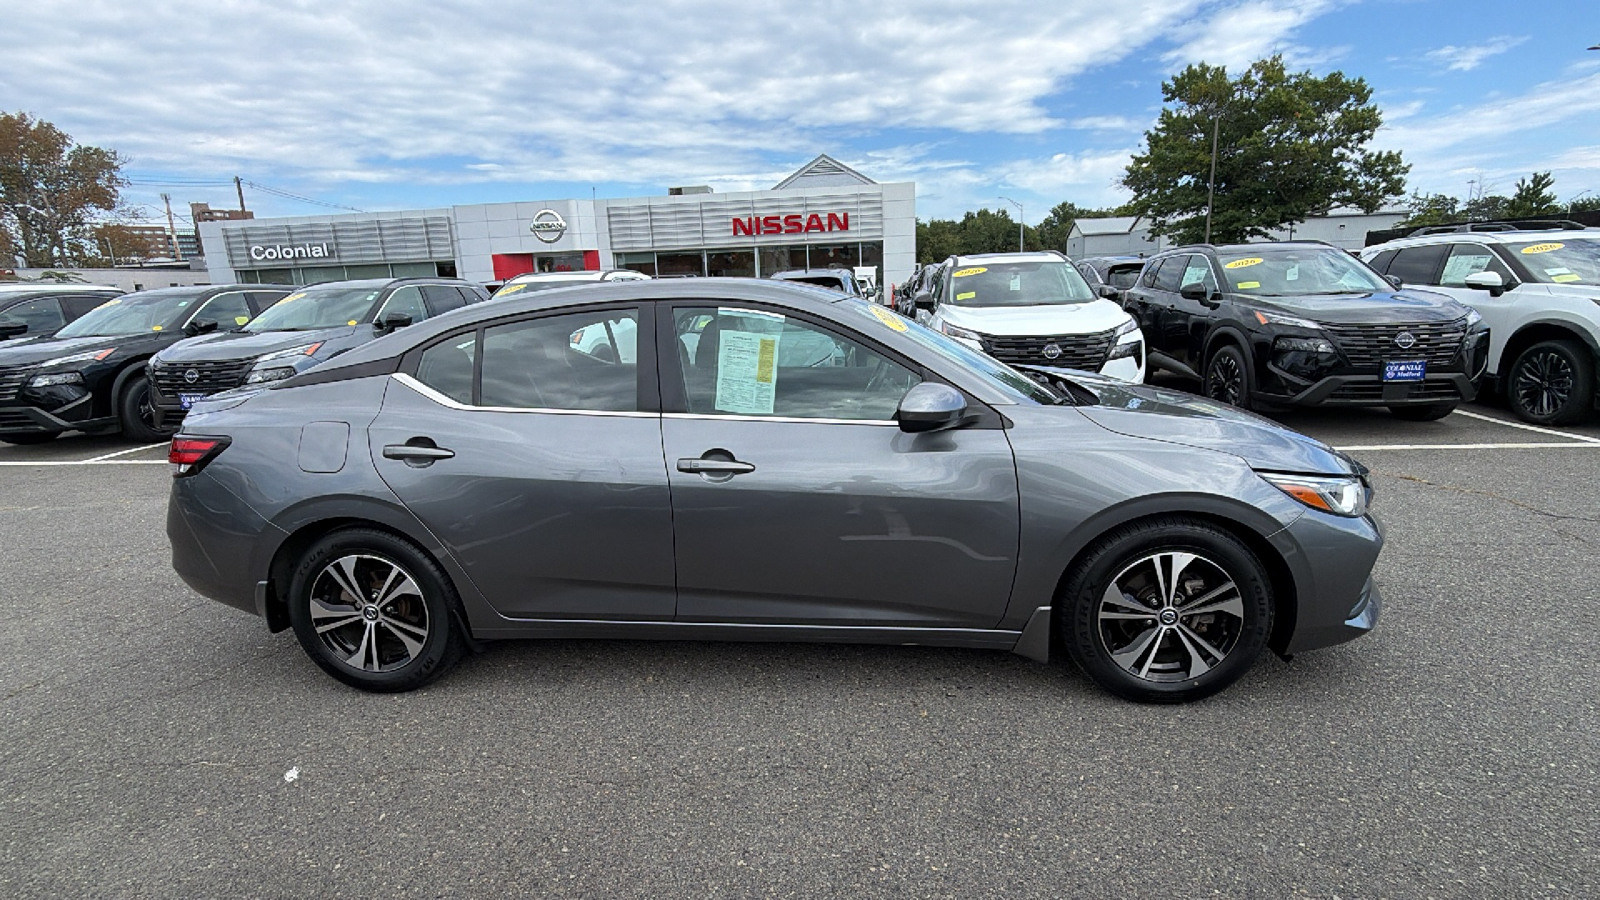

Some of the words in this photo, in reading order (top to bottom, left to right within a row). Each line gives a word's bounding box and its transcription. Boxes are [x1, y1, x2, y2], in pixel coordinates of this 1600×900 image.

[732, 212, 849, 236] NISSAN
[250, 242, 329, 260] Colonial
[1385, 364, 1424, 372] COLONIAL
